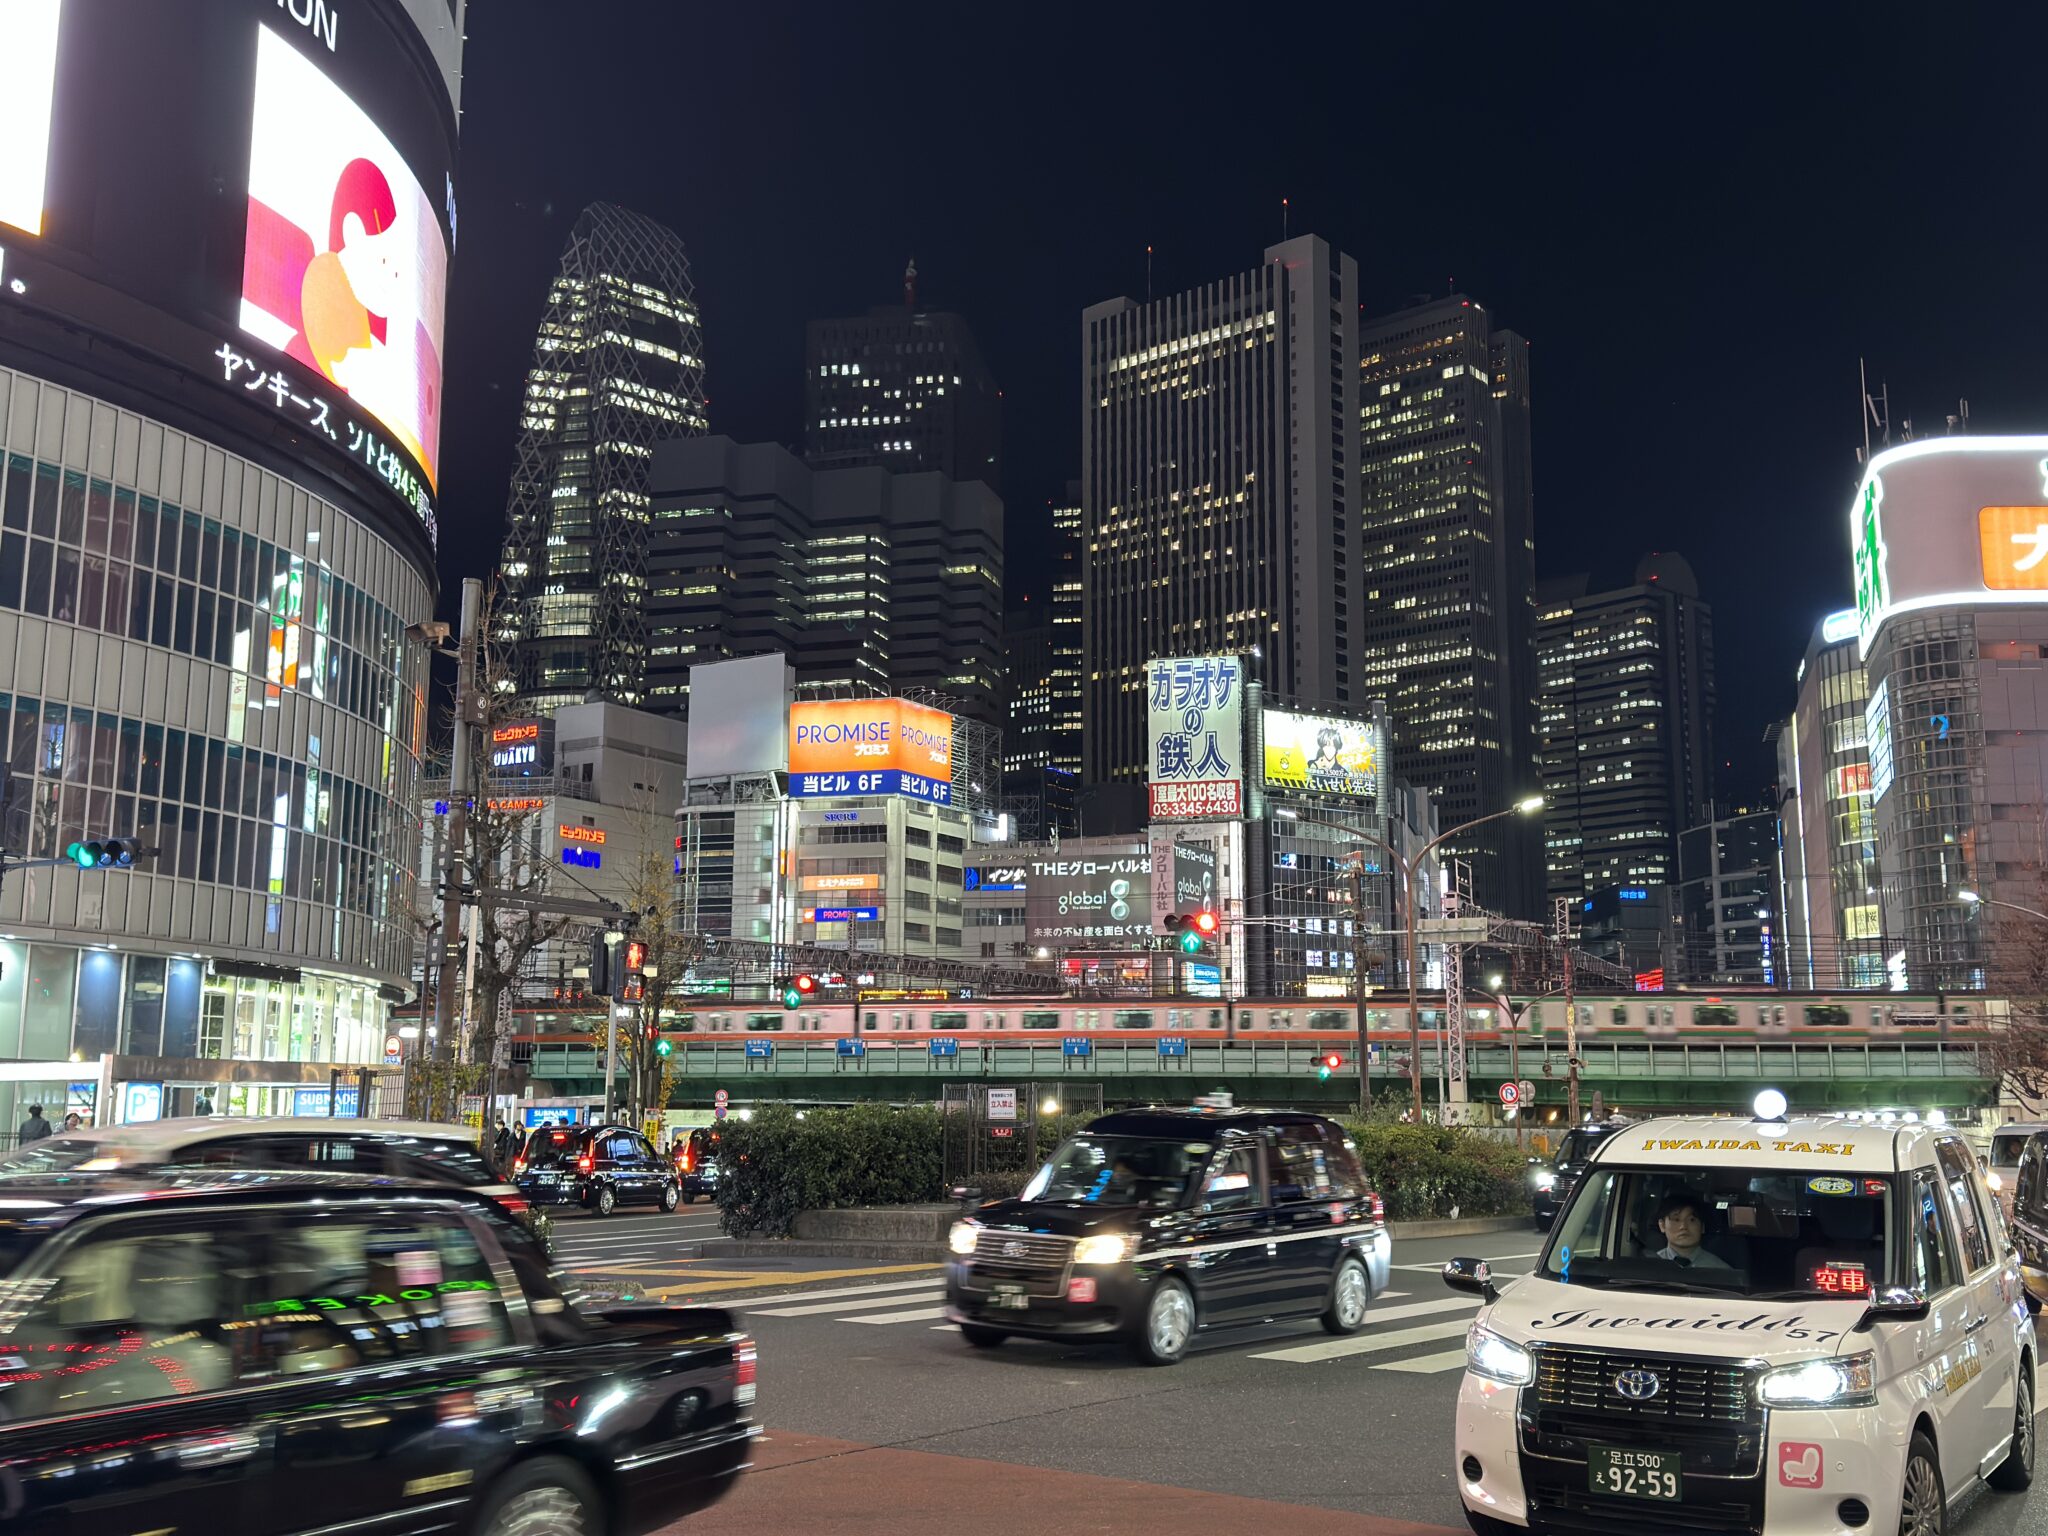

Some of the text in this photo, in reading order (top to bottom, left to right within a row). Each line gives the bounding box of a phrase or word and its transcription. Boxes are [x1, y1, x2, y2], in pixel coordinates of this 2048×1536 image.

[552, 486, 578, 498] MODE
[546, 535, 568, 546] HAL
[1151, 658, 1236, 711] カラオケ
[1182, 706, 1204, 737] の
[493, 725, 538, 742] ビックカメラ
[797, 722, 890, 745] PROMISE
[901, 725, 948, 753] PROMISE
[853, 743, 890, 756] プロミス
[1156, 732, 1231, 779] 鉄人
[803, 774, 883, 793] 当ビル 6F
[900, 774, 948, 800] 当ビル 6F
[1152, 782, 1237, 803] 1室最大100名収容
[559, 824, 607, 844] ビックカメラ
[1174, 846, 1214, 867] THEグローバル社
[989, 868, 1027, 883] インタ
[1032, 859, 1151, 877] THEグローバル社
[1178, 876, 1202, 903] global
[1058, 890, 1107, 915] global
[960, 989, 972, 999] 24
[1642, 1139, 1856, 1156] IWAIDA TAXI
[1816, 1268, 1865, 1292] 空車
[1530, 1308, 1808, 1331] Iwaida
[1785, 1328, 1839, 1343] 57
[1610, 1451, 1661, 1469] 足立 500
[1596, 1467, 1677, 1498] え 92-59
